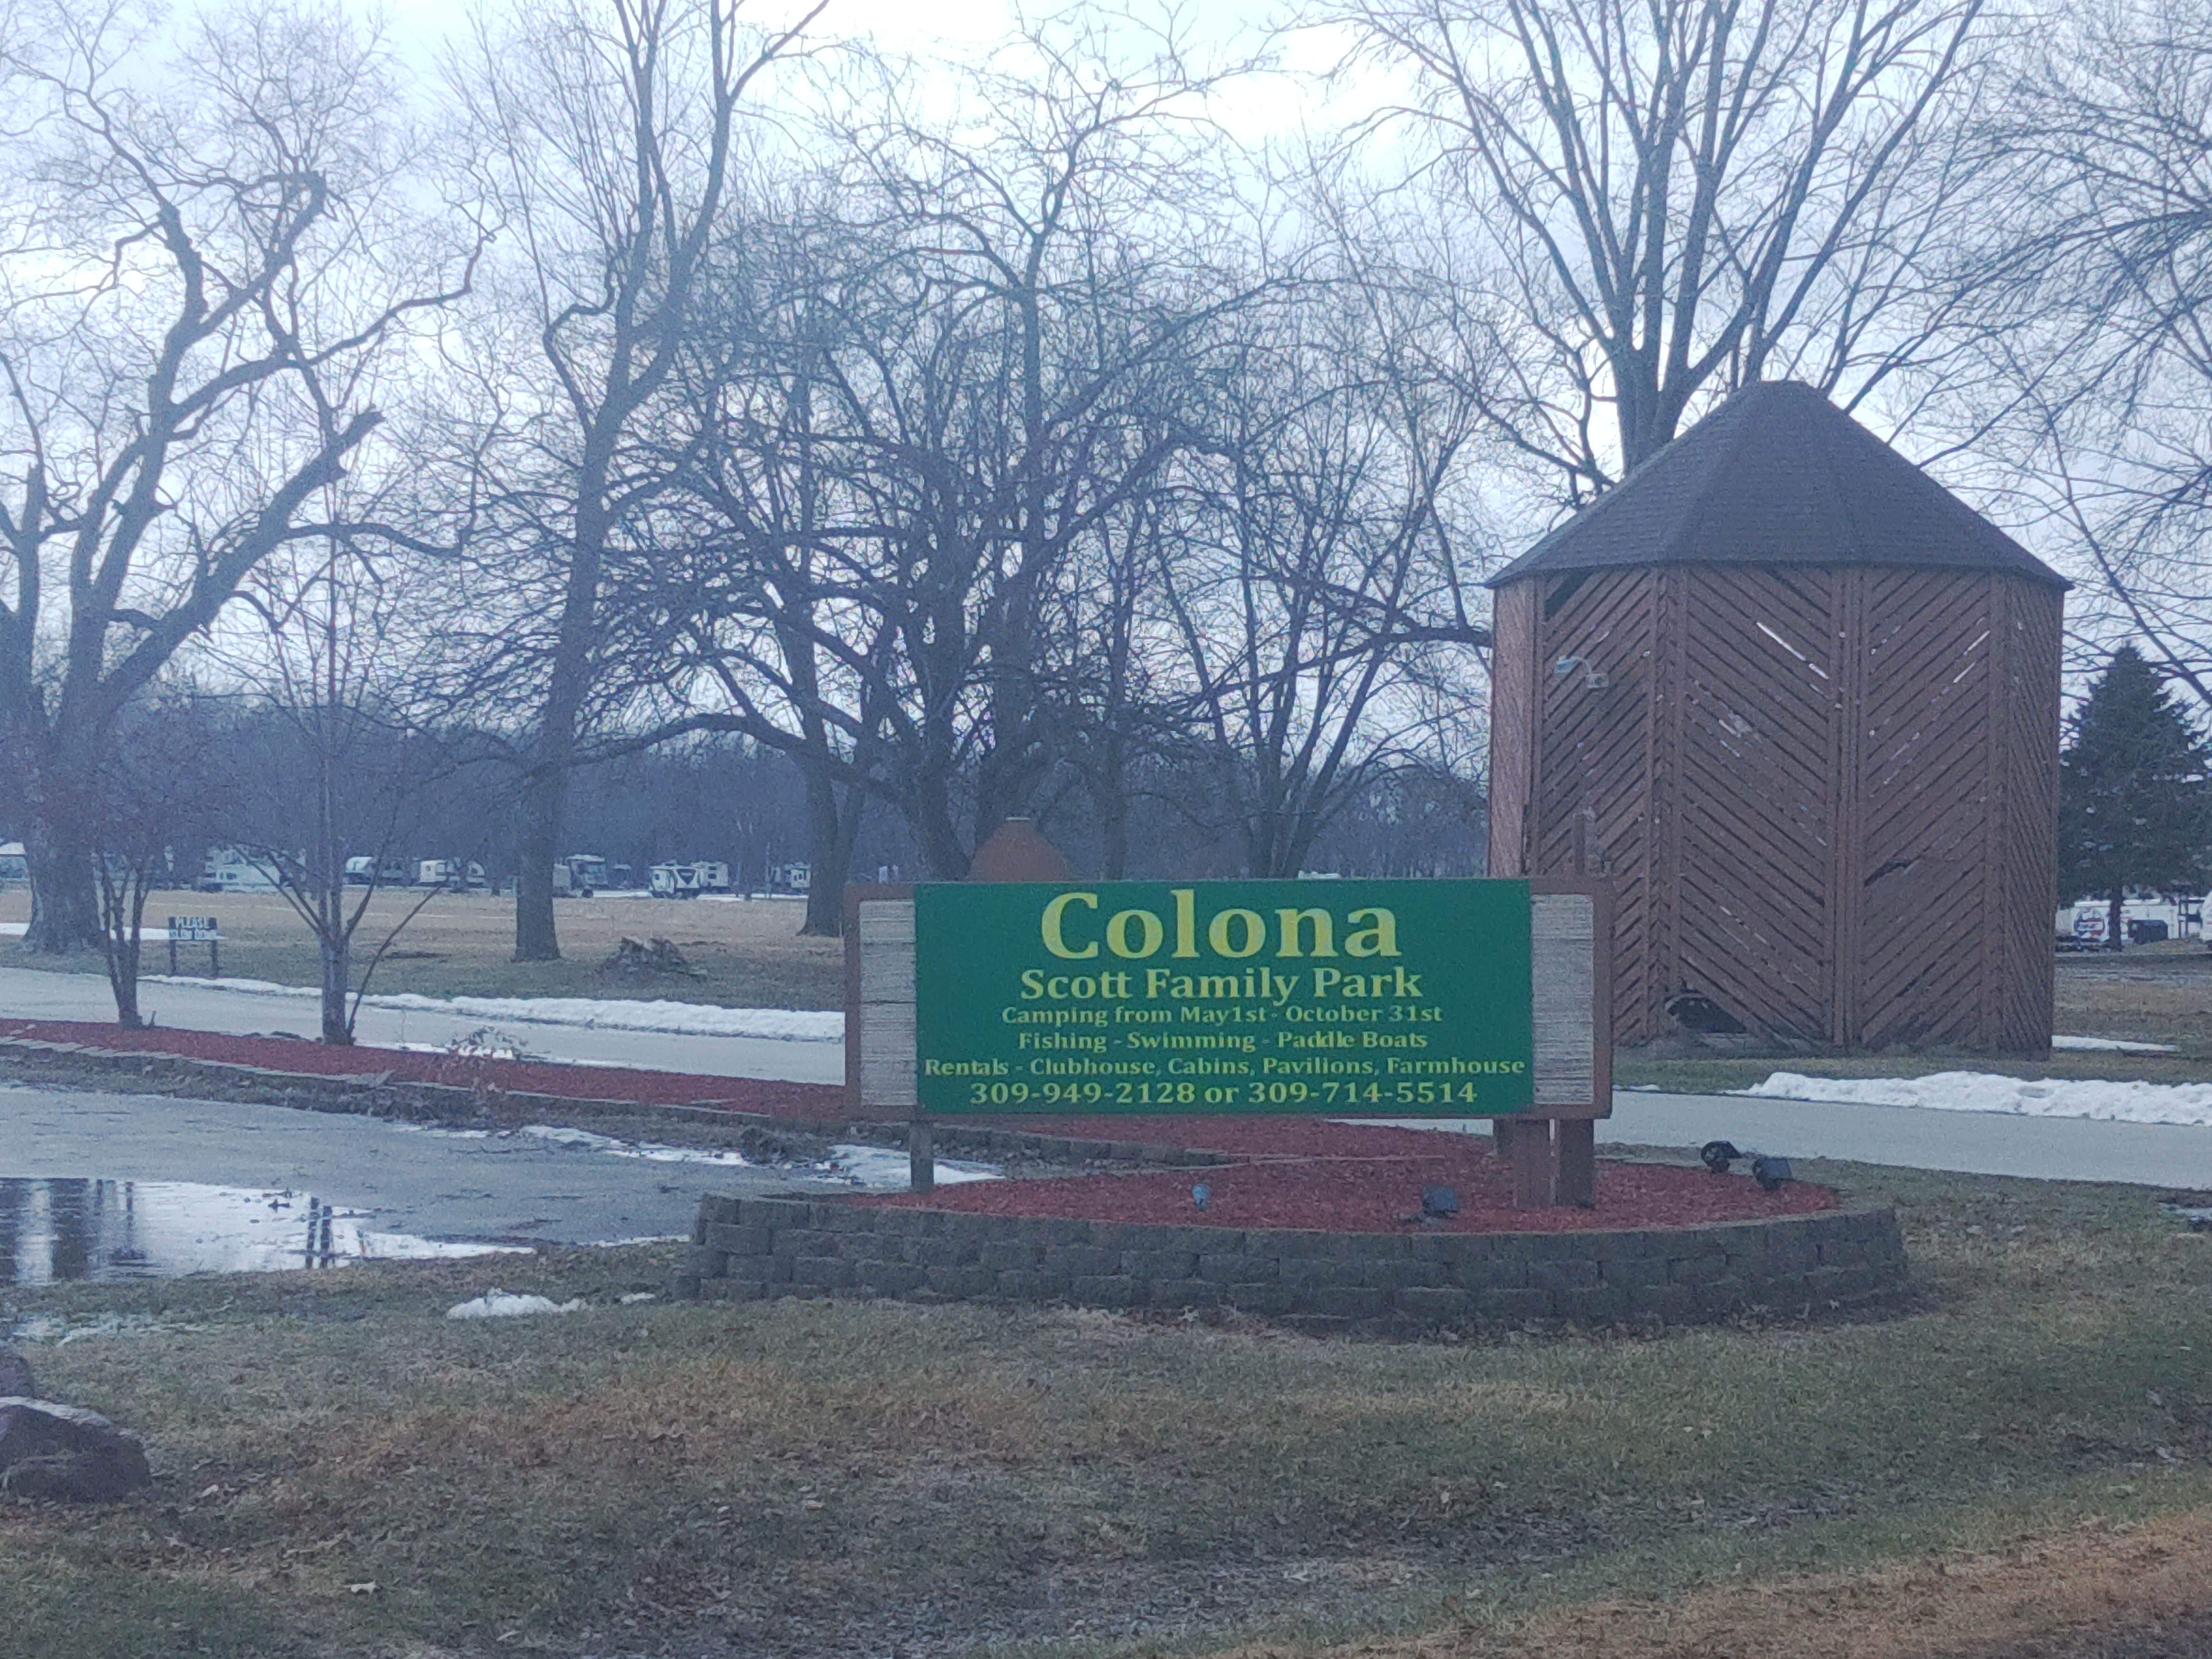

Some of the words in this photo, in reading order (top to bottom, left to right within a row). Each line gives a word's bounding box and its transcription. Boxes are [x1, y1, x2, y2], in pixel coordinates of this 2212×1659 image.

[1041, 889, 1402, 959] Colona
[1021, 969, 1133, 999] Scott
[1146, 967, 1300, 1005] Family
[1313, 966, 1423, 997] Park
[1002, 1006, 1108, 1027] Camping
[1115, 1006, 1173, 1023] from
[1286, 1005, 1383, 1022] October
[1389, 1006, 1443, 1022] 31st
[1019, 1032, 1107, 1053] Fishing
[1127, 1031, 1256, 1052] Swimming
[1277, 1031, 1355, 1047] Paddle
[1362, 1031, 1428, 1048] Boats
[924, 1058, 1009, 1076] Rentals
[1029, 1058, 1161, 1076] Clubhouse,
[1167, 1058, 1255, 1076] Cabins,
[1263, 1057, 1379, 1076] Pavilions,
[1386, 1056, 1525, 1074] Farmhouse
[970, 1083, 1196, 1104] 309-949-2128
[1204, 1087, 1239, 1104] or
[1248, 1082, 1477, 1103] 309-714-5514
